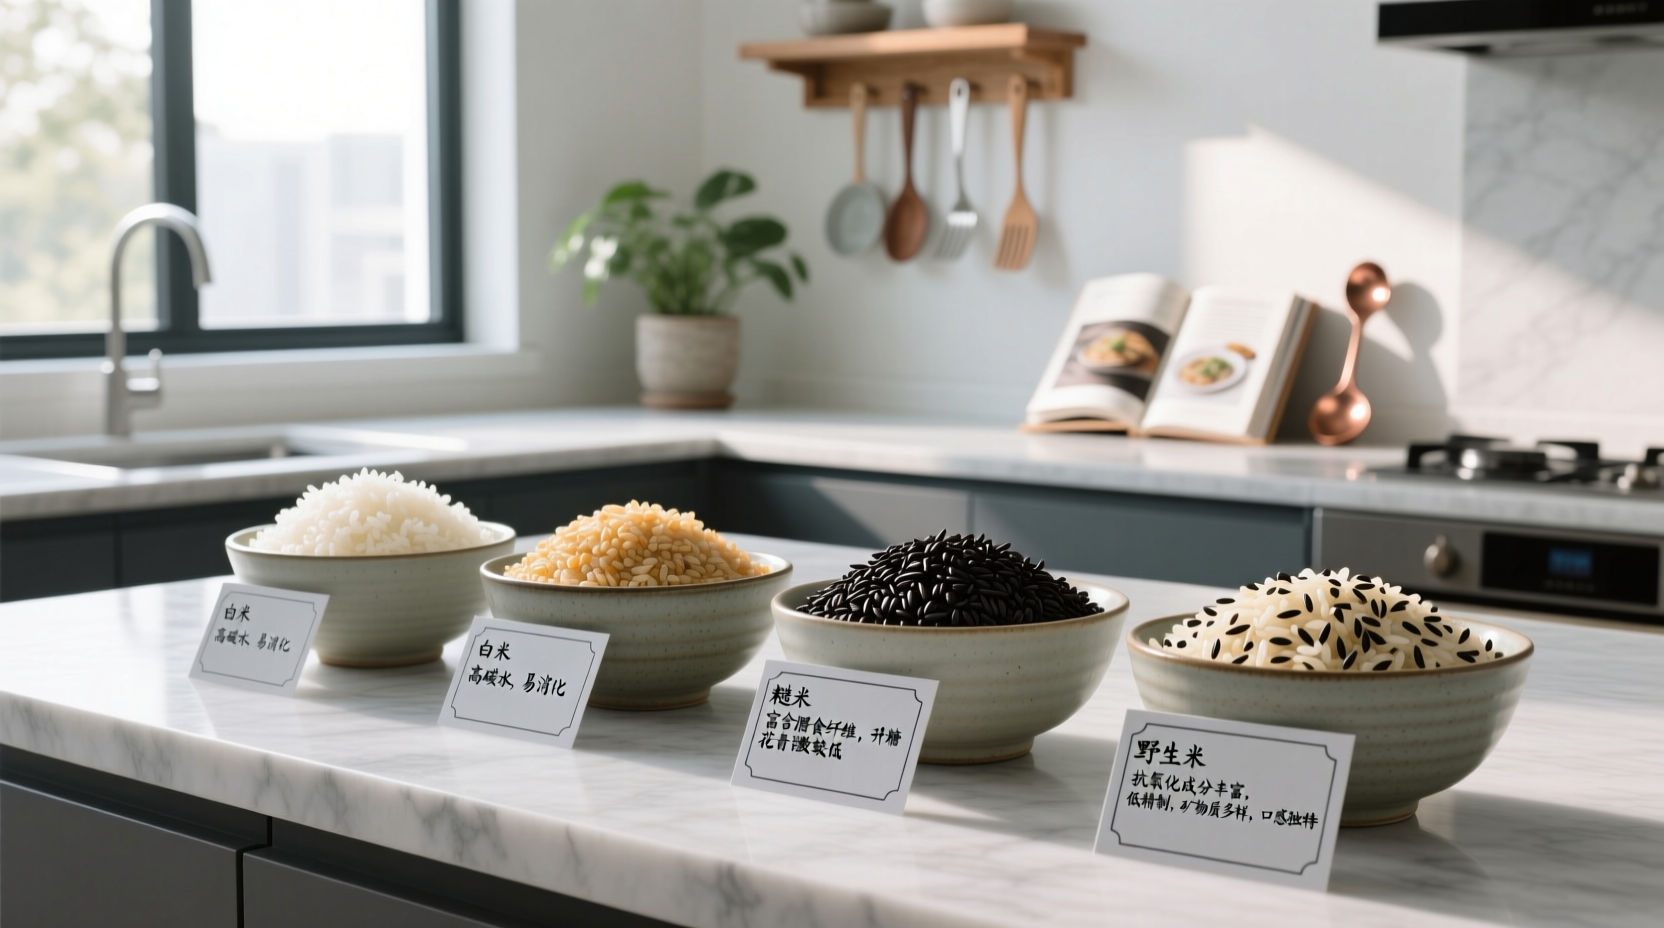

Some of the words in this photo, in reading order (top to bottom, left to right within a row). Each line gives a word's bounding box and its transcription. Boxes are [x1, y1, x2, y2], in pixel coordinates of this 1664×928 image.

[224, 603, 250, 622] 白米
[479, 639, 511, 661] 白米
[769, 683, 812, 708] 糙米
[1133, 740, 1206, 769] 野生米
